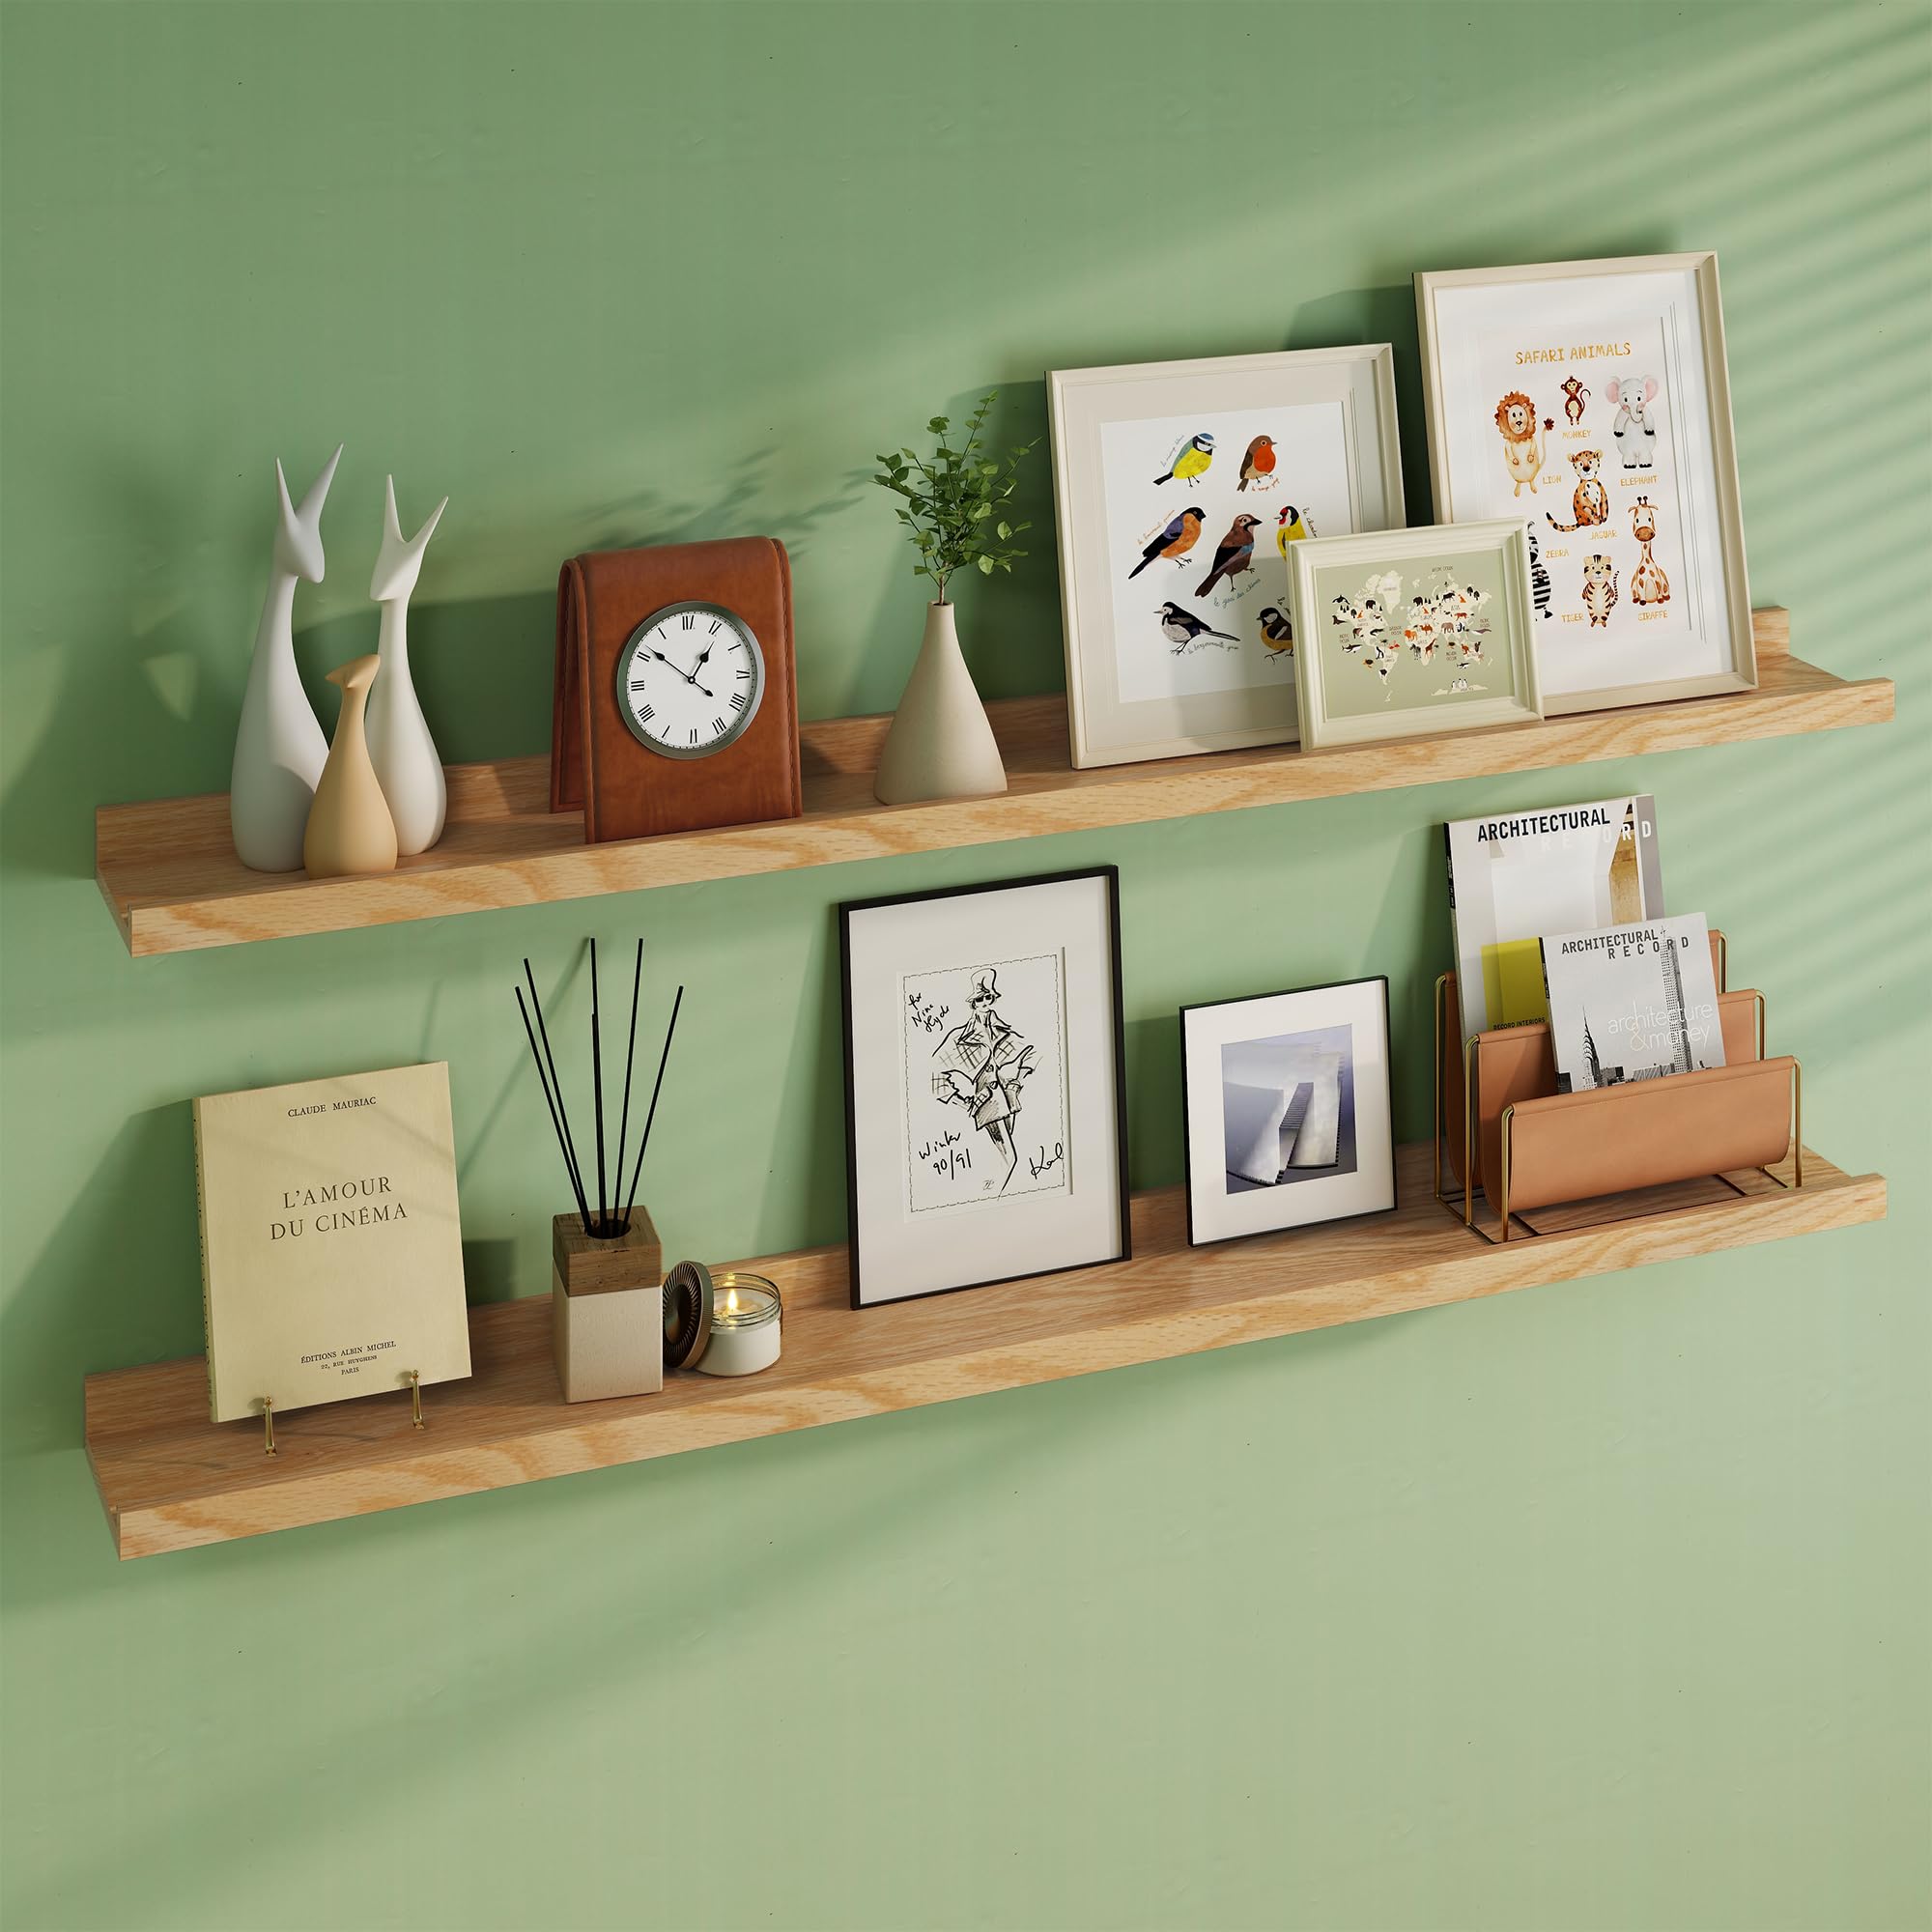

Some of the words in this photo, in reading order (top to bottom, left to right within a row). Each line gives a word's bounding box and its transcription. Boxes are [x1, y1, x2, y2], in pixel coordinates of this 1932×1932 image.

[1515, 348, 1565, 365] SAFARI
[1570, 342, 1631, 360] ANIMALS
[1562, 429, 1591, 440] MONKEY
[1543, 474, 1562, 485] LION
[1620, 474, 1658, 487] ELEPHANT
[1590, 529, 1617, 540] JAGUAR
[1546, 549, 1570, 558] ZEBRA
[1561, 612, 1584, 623] TIGER
[1638, 610, 1668, 621] GIRAFFE
[1477, 808, 1611, 843] ARCHITECTURAL
[1540, 820, 1653, 852] REORD
[1561, 928, 1659, 954] ARCHITECTURAL
[1607, 936, 1690, 960] RECORD
[1493, 1021, 1516, 1031] RECORD
[1517, 1017, 1546, 1027] INTERIORS
[1607, 998, 1714, 1035] architecture
[288, 1104, 327, 1118] CLAUDE
[332, 1096, 377, 1111] MAURIAC
[933, 1148, 972, 1180] 90/91
[283, 1176, 391, 1209] L'AMOUR
[270, 1219, 304, 1241] DU
[315, 1202, 408, 1233] CINÉMA
[300, 1350, 337, 1364] ÉDITIONS
[340, 1346, 363, 1357] ALBIN
[367, 1340, 397, 1352] MICHEL
[341, 1366, 359, 1376] PARIS
